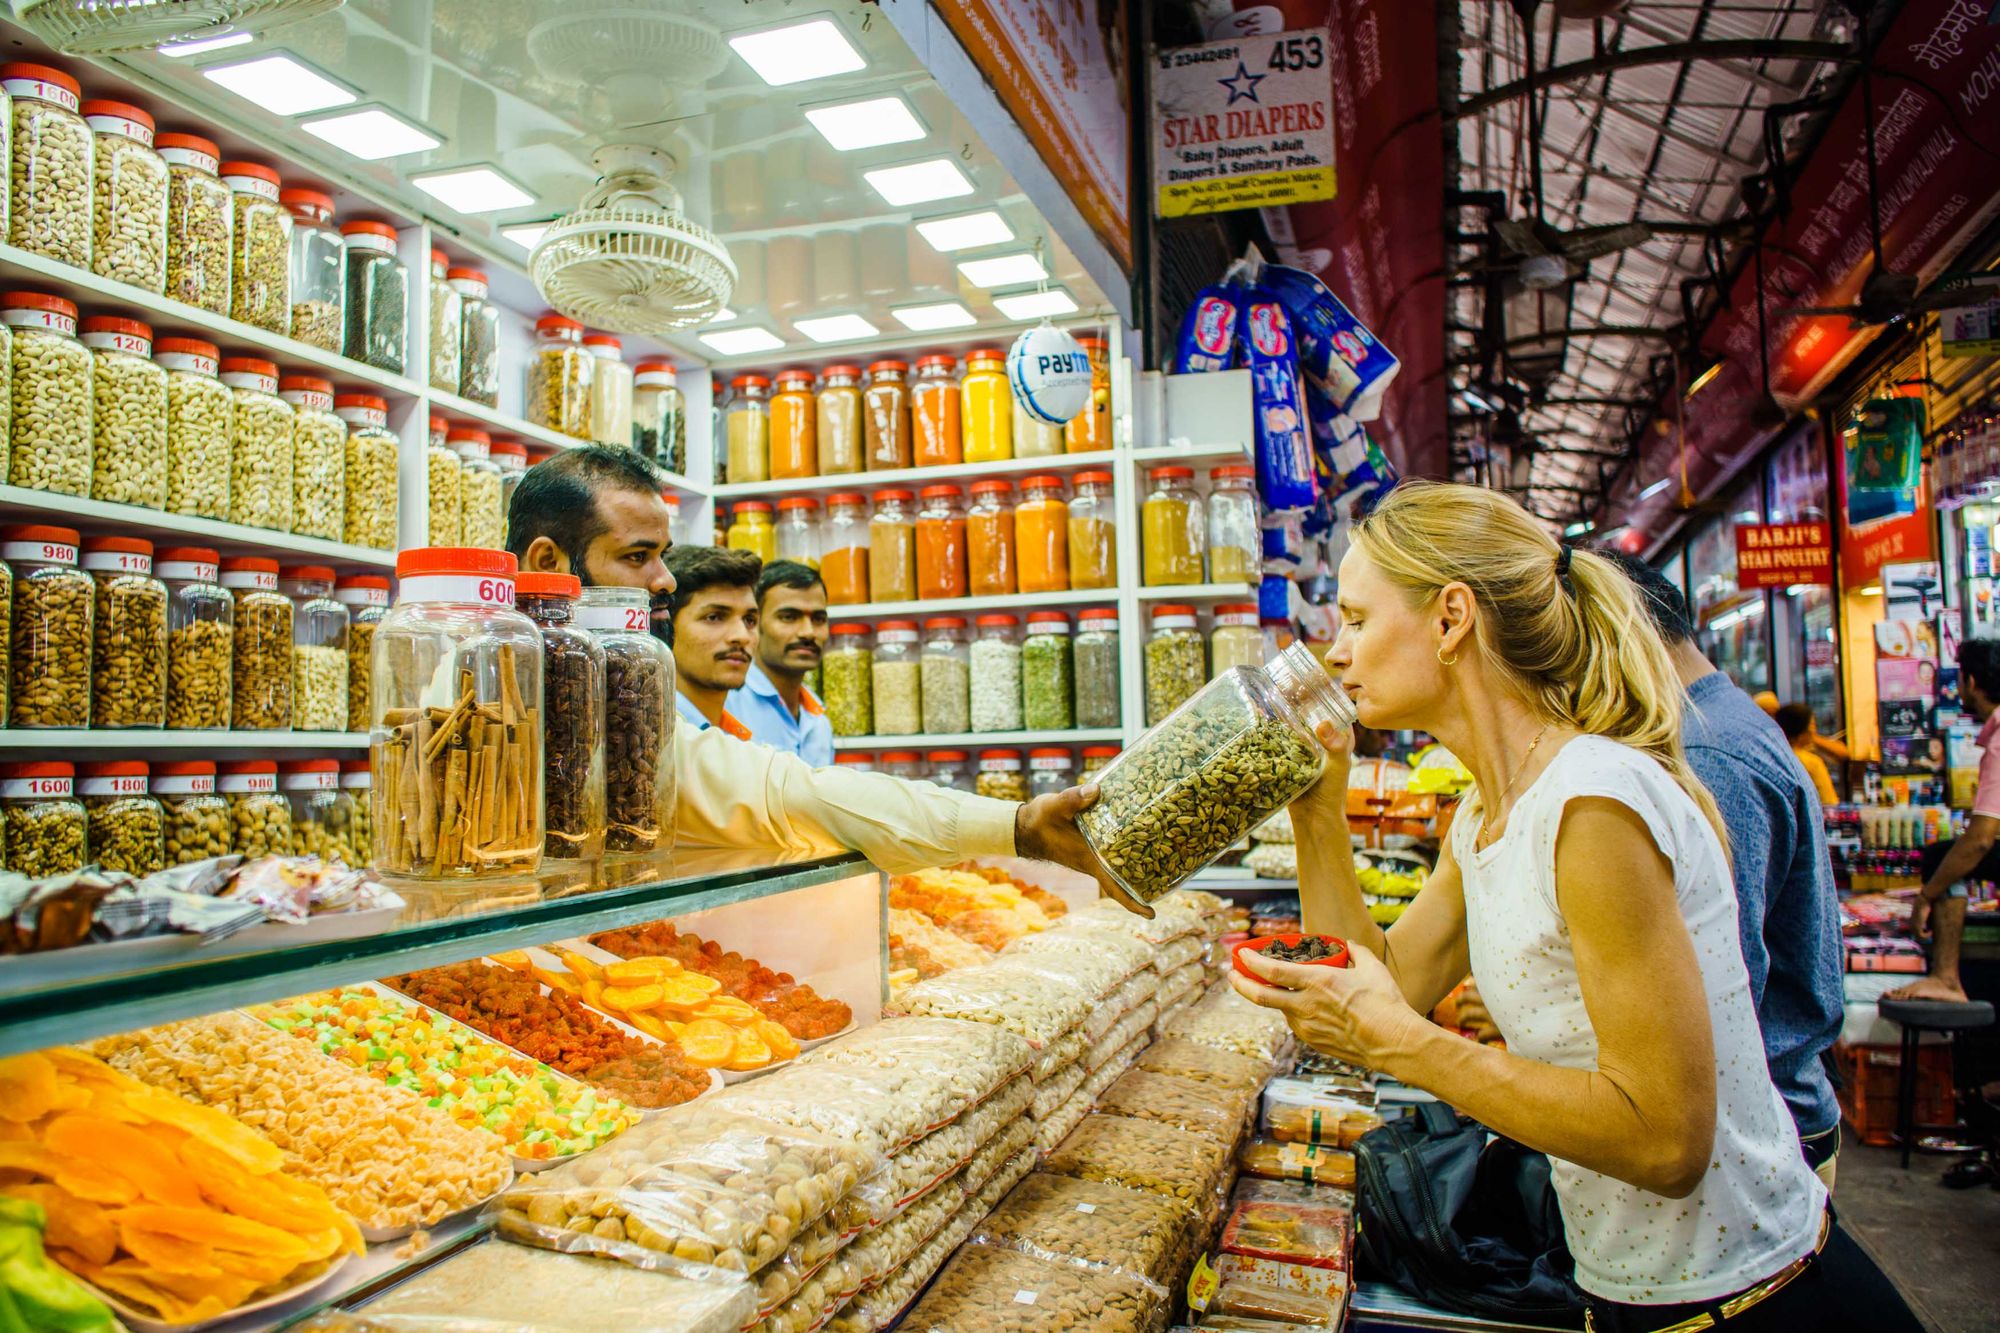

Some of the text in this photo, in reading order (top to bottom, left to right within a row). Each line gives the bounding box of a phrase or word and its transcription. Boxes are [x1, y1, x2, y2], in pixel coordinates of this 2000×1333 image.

[1268, 36, 1324, 72] 453
[1163, 101, 1326, 148] STAR DIAPERS
[1746, 526, 1822, 548] BABJI'S
[43, 544, 75, 561] 980
[1739, 547, 1830, 569] STAR POULTRY
[478, 579, 514, 606] 600
[28, 780, 70, 794] 1600
[110, 779, 146, 792] 1800
